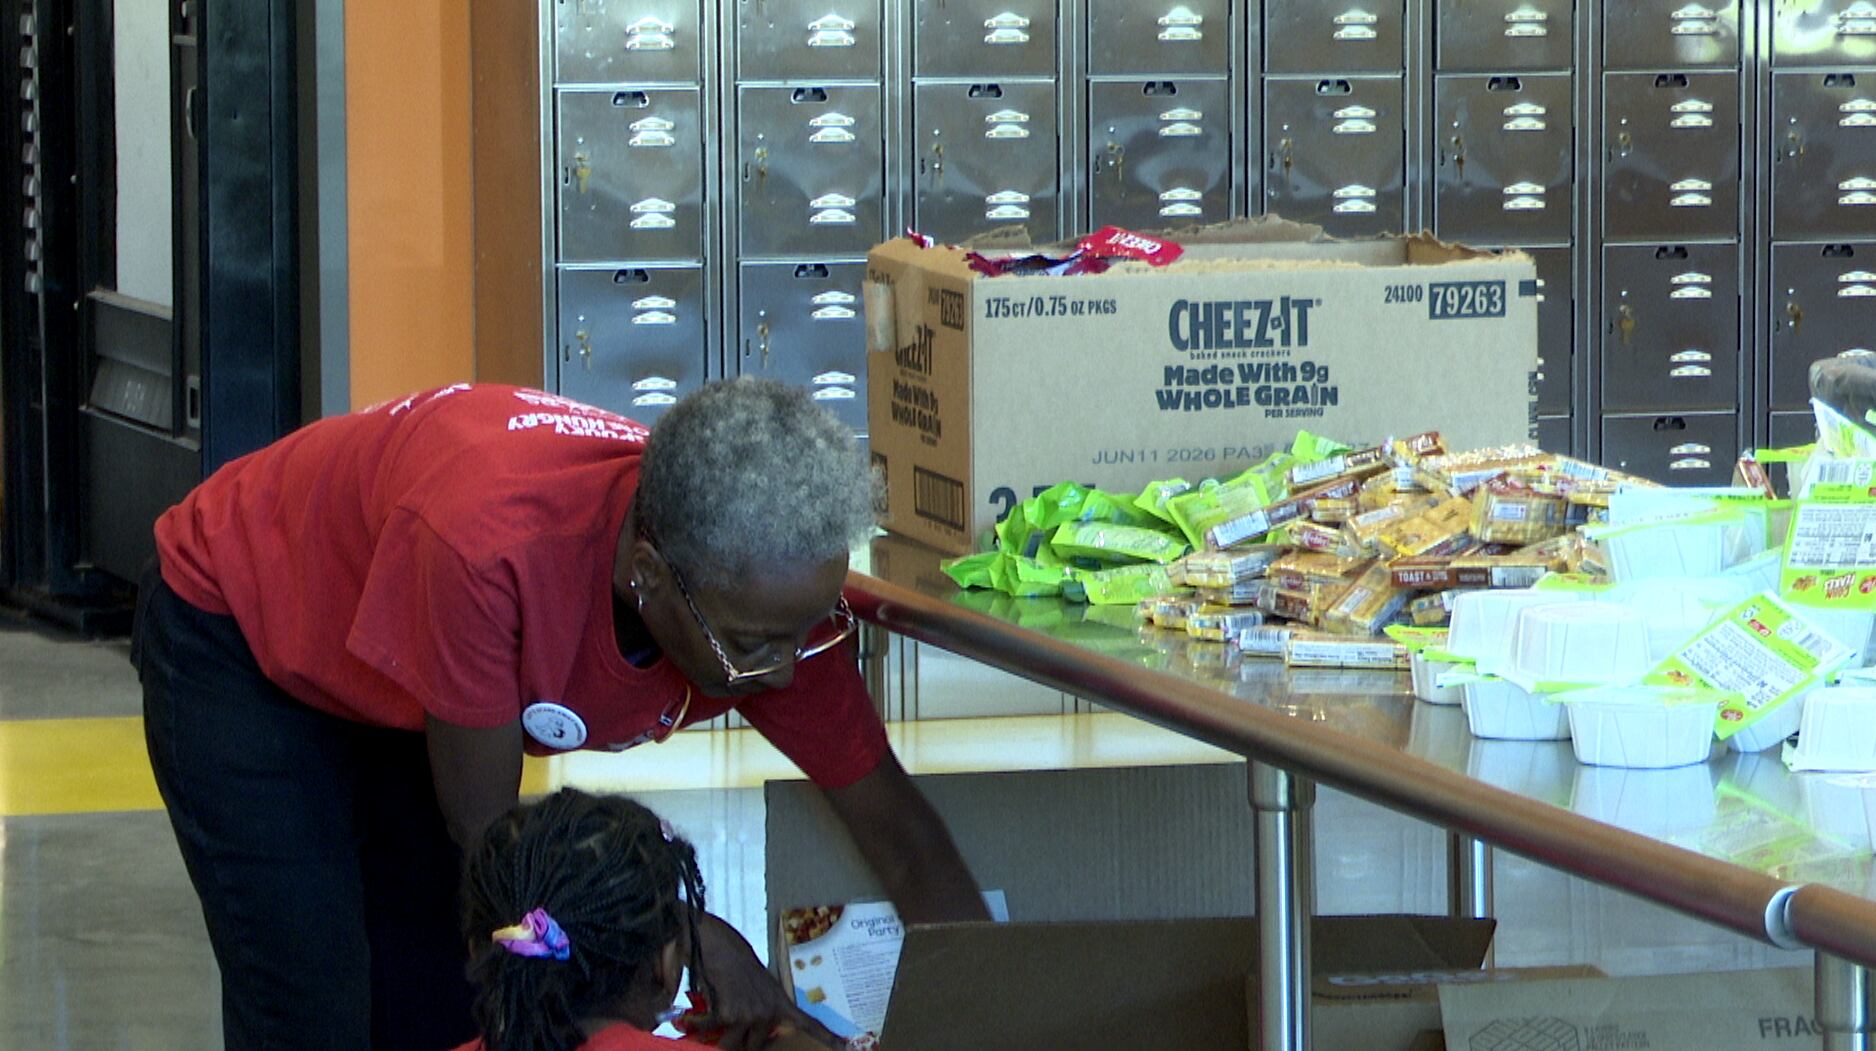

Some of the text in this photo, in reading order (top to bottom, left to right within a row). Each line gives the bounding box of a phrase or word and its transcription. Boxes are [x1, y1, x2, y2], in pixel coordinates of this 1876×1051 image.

[1088, 299, 1118, 316] PKGS
[1384, 285, 1503, 316] 24100 79263
[1189, 349, 1291, 361] baked snack crackers
[1163, 361, 1330, 386] Made With 9g
[1155, 383, 1339, 412] WHOLE GRAIN
[507, 412, 606, 432] HUNGRY
[1264, 407, 1325, 419] PER SERVING
[1398, 570, 1425, 583] TOAST
